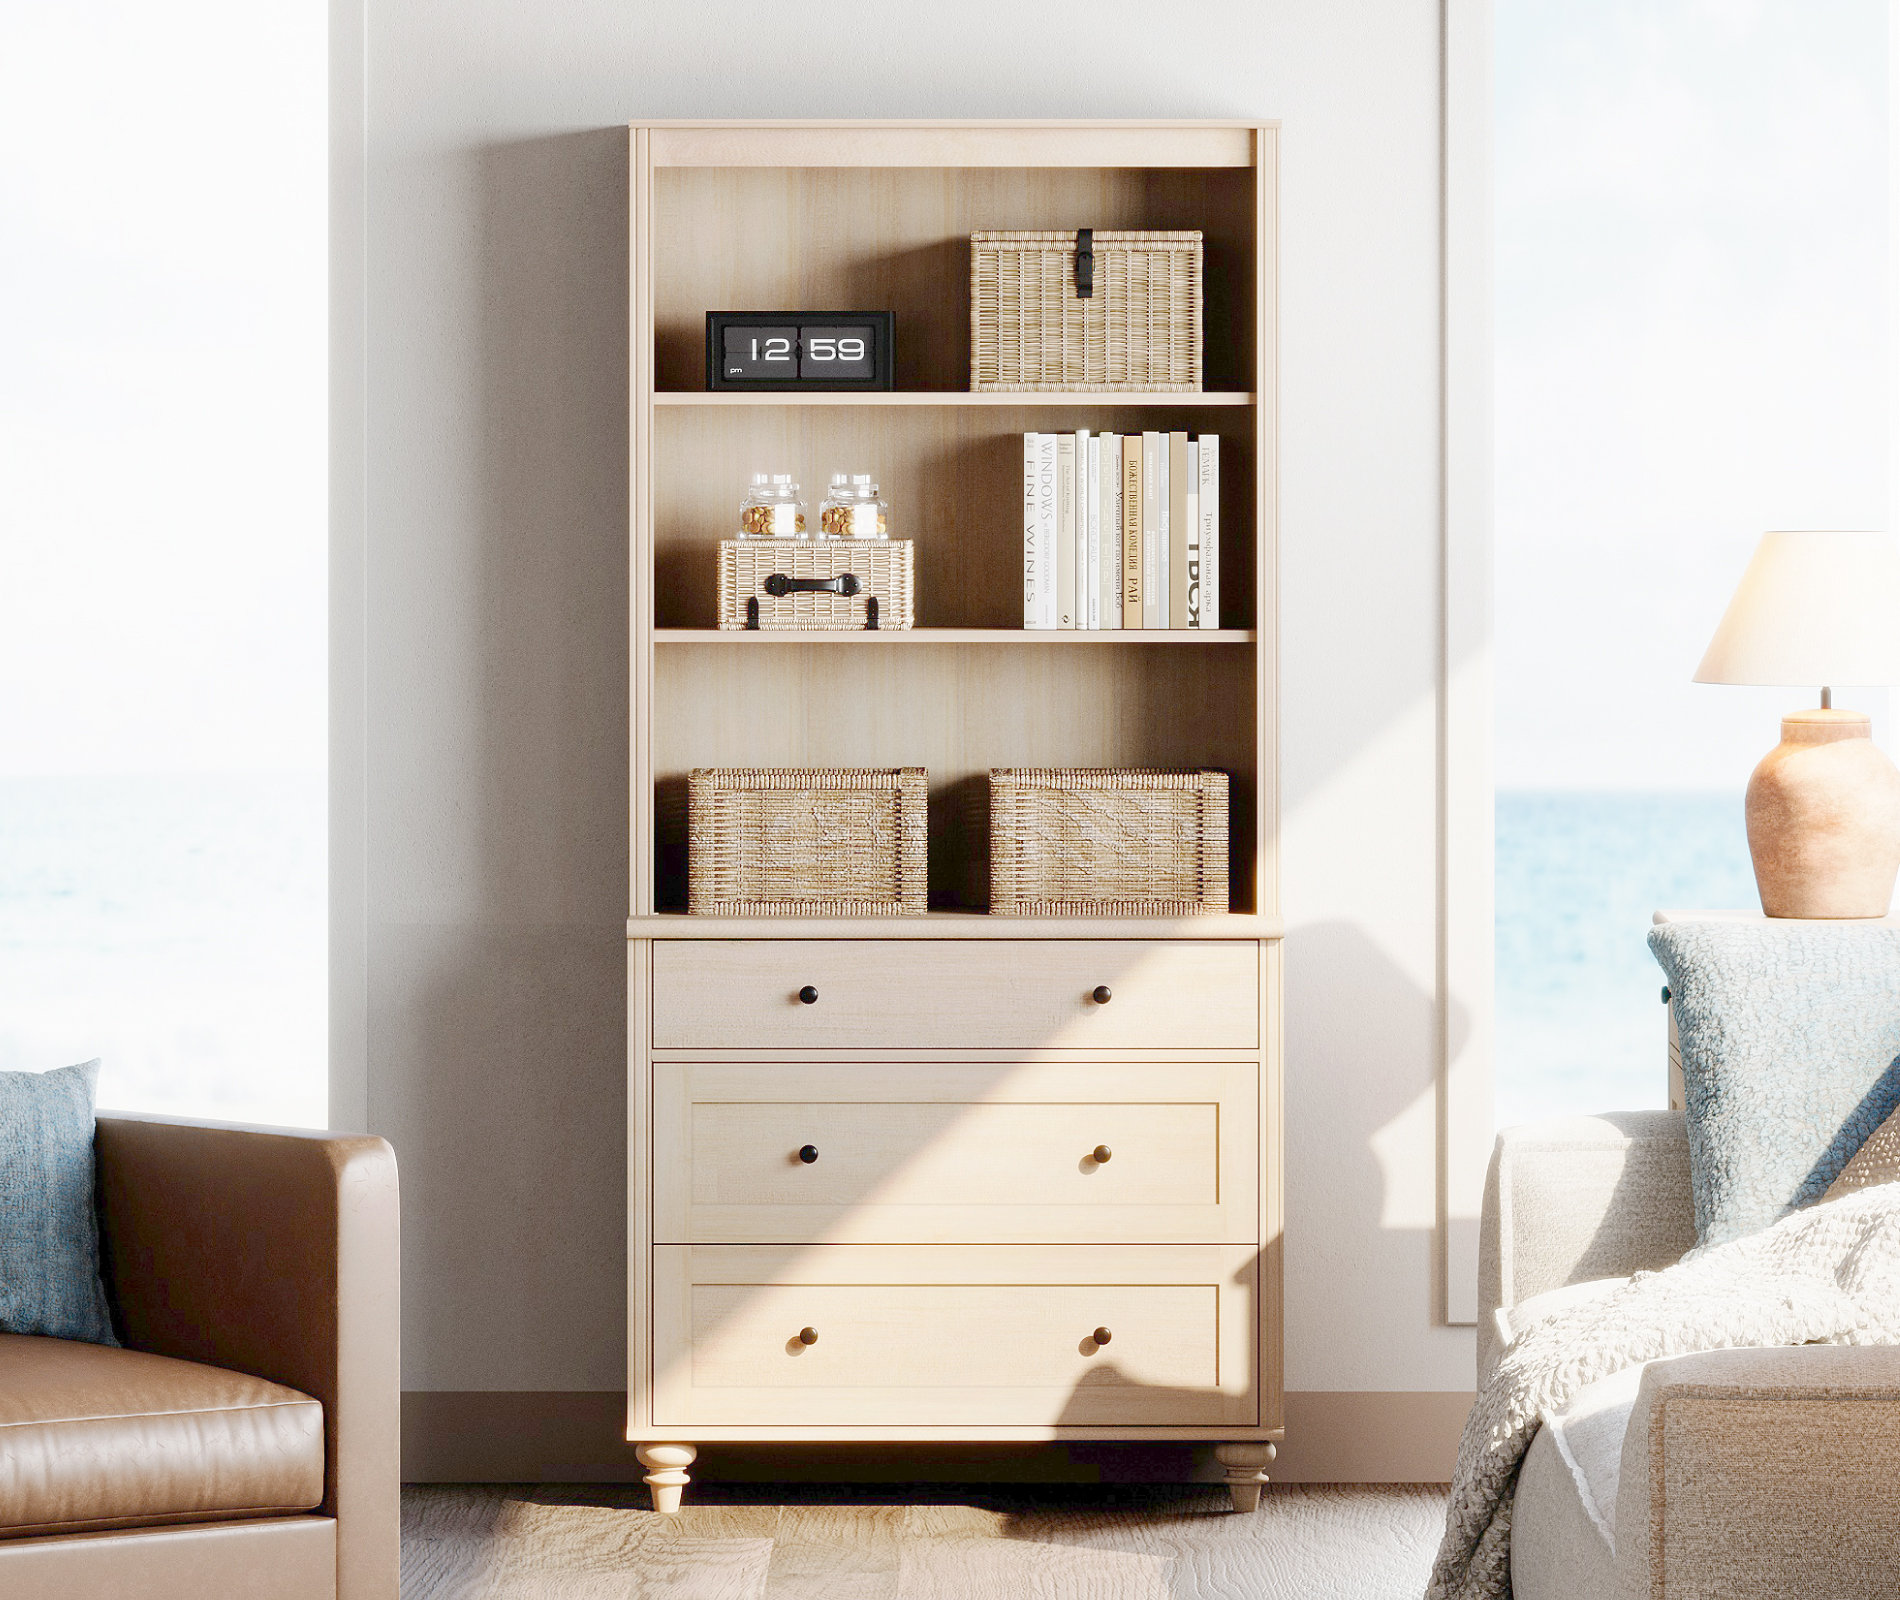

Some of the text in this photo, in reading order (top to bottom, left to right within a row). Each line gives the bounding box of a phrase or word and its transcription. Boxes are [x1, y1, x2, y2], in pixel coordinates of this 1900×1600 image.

[751, 338, 865, 361] 12 59
[1026, 460, 1036, 602] FINE WINES
[1041, 441, 1053, 520] WINDOWS
[1128, 460, 1141, 603] БОЖЕСТВЕННАЯ КОМЕДИЯ РАЙ
[1203, 511, 1213, 613] Триумфальная арка
